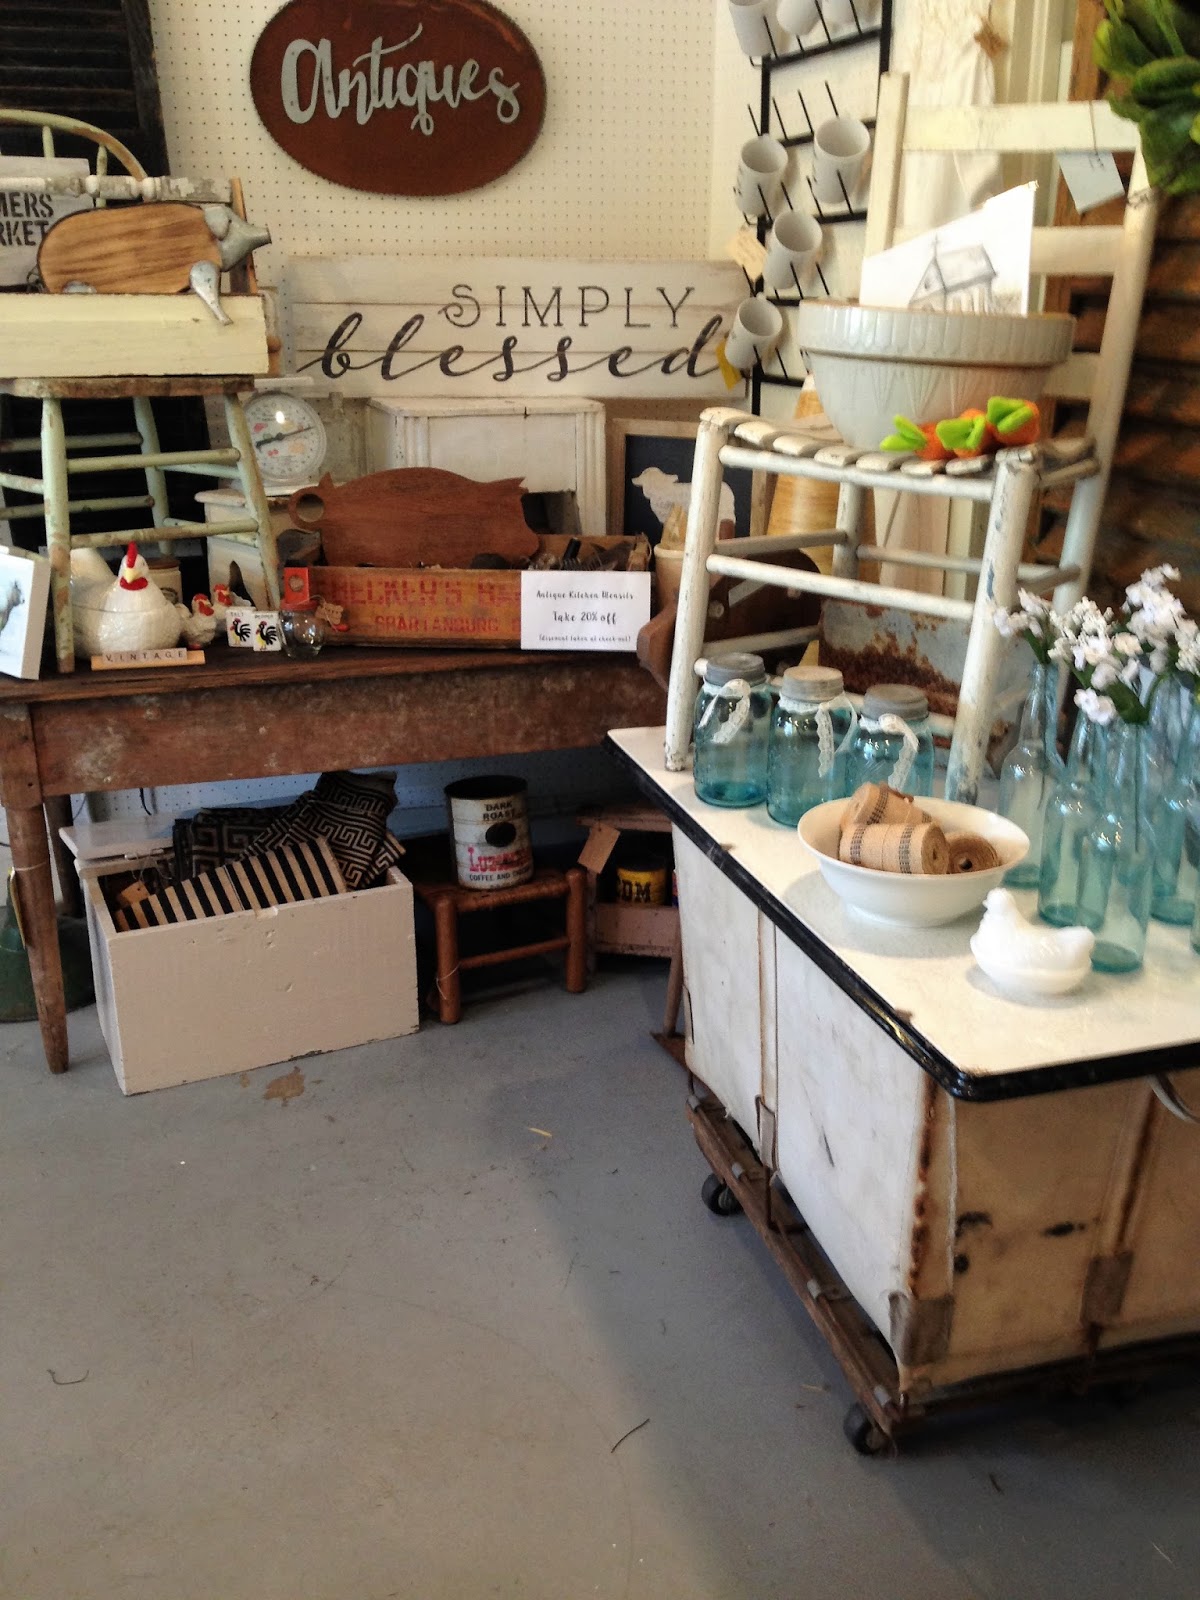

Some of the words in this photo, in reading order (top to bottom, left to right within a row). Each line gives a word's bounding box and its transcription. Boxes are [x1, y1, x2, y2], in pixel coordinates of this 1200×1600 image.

[281, 23, 520, 135] Antiques
[438, 283, 695, 328] SIMPLY
[297, 312, 724, 382] blessed
[536, 590, 566, 600] Antique
[569, 590, 599, 599] Kitchen
[553, 611, 577, 622] Take
[580, 611, 598, 622] 20%
[600, 612, 617, 625] off
[105, 650, 185, 663] VINTAGE
[485, 801, 513, 812] DARK
[483, 810, 516, 821] ROAST
[496, 872, 511, 880] AND
